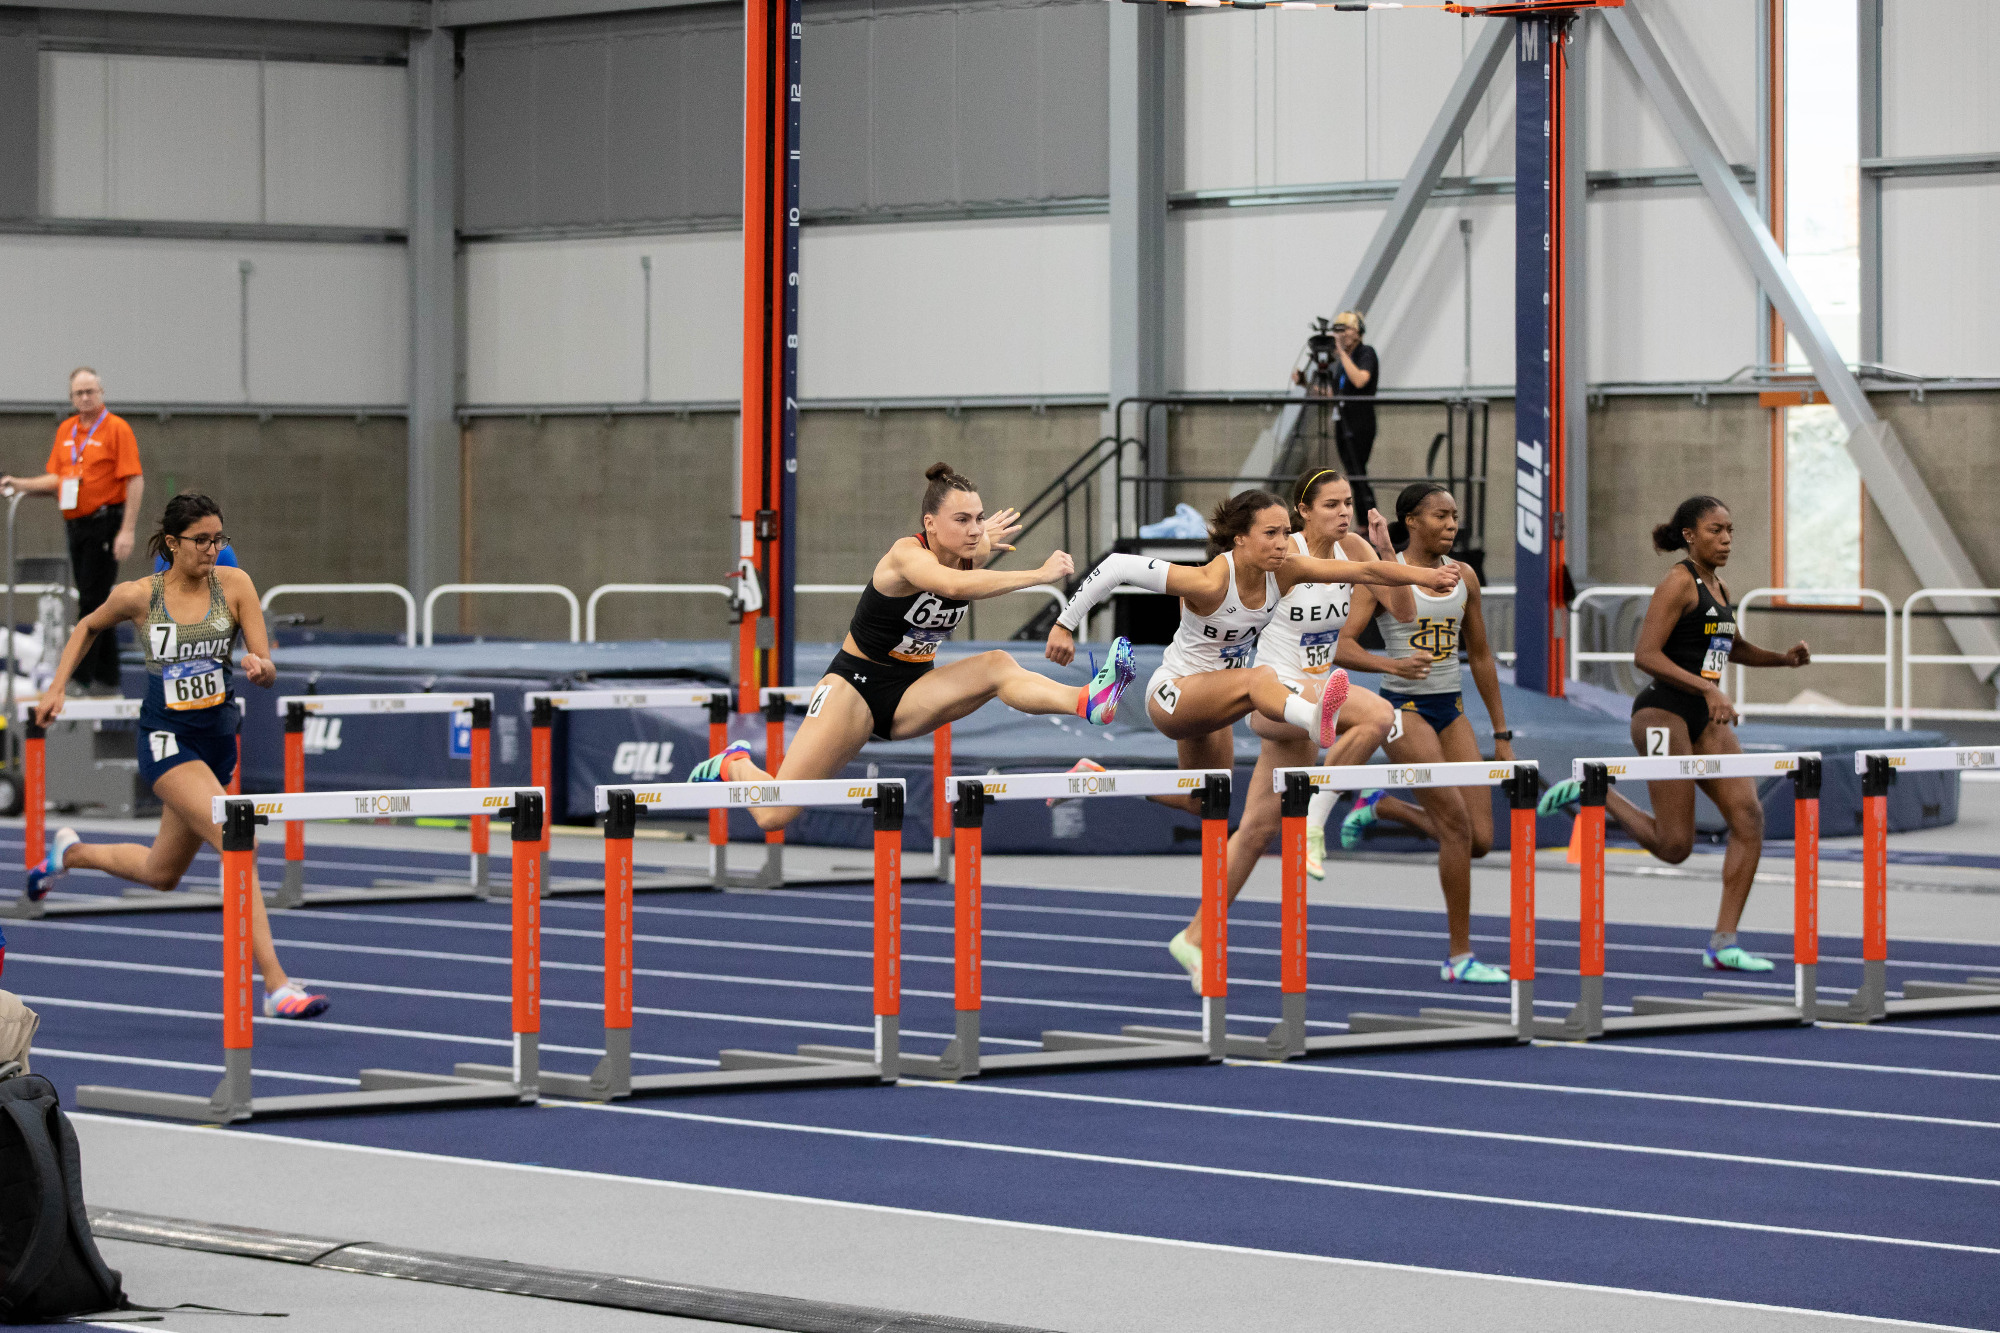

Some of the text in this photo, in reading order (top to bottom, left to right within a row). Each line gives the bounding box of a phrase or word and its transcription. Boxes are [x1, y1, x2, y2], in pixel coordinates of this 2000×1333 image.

[791, 22, 801, 39] 13
[790, 84, 801, 102] 12
[790, 150, 800, 159] 11
[789, 207, 800, 226] 10
[1543, 233, 1550, 250] 10
[788, 272, 799, 286] 9
[787, 334, 798, 348] 8
[786, 397, 798, 410] 7
[785, 458, 797, 473] 6
[1517, 440, 1543, 555] GILL
[912, 598, 937, 625] 6
[1704, 622, 1717, 635] UC
[156, 626, 171, 656] 7
[179, 638, 231, 661] DAVIS
[175, 672, 217, 701] 686
[810, 686, 828, 715] 6
[1158, 683, 1177, 708] 5
[304, 717, 342, 750] ILL
[154, 734, 169, 759] 7
[1651, 730, 1664, 756] 2
[612, 742, 675, 775] GILL
[1774, 760, 1795, 770] GILL
[1956, 752, 1966, 766] THE
[1489, 769, 1511, 779] GILL
[1607, 765, 1627, 775] GILL
[1680, 760, 1690, 775] THE
[1177, 778, 1201, 788] GILL
[1309, 774, 1331, 785] GILL
[1387, 769, 1399, 785] THE
[847, 787, 873, 798] GILL
[983, 783, 1008, 794] GILL
[1068, 778, 1080, 794] THE
[482, 796, 510, 807] GILL
[635, 792, 662, 803] GILL
[729, 787, 742, 804] THE
[254, 802, 284, 814] GILL
[355, 797, 369, 814] THE
